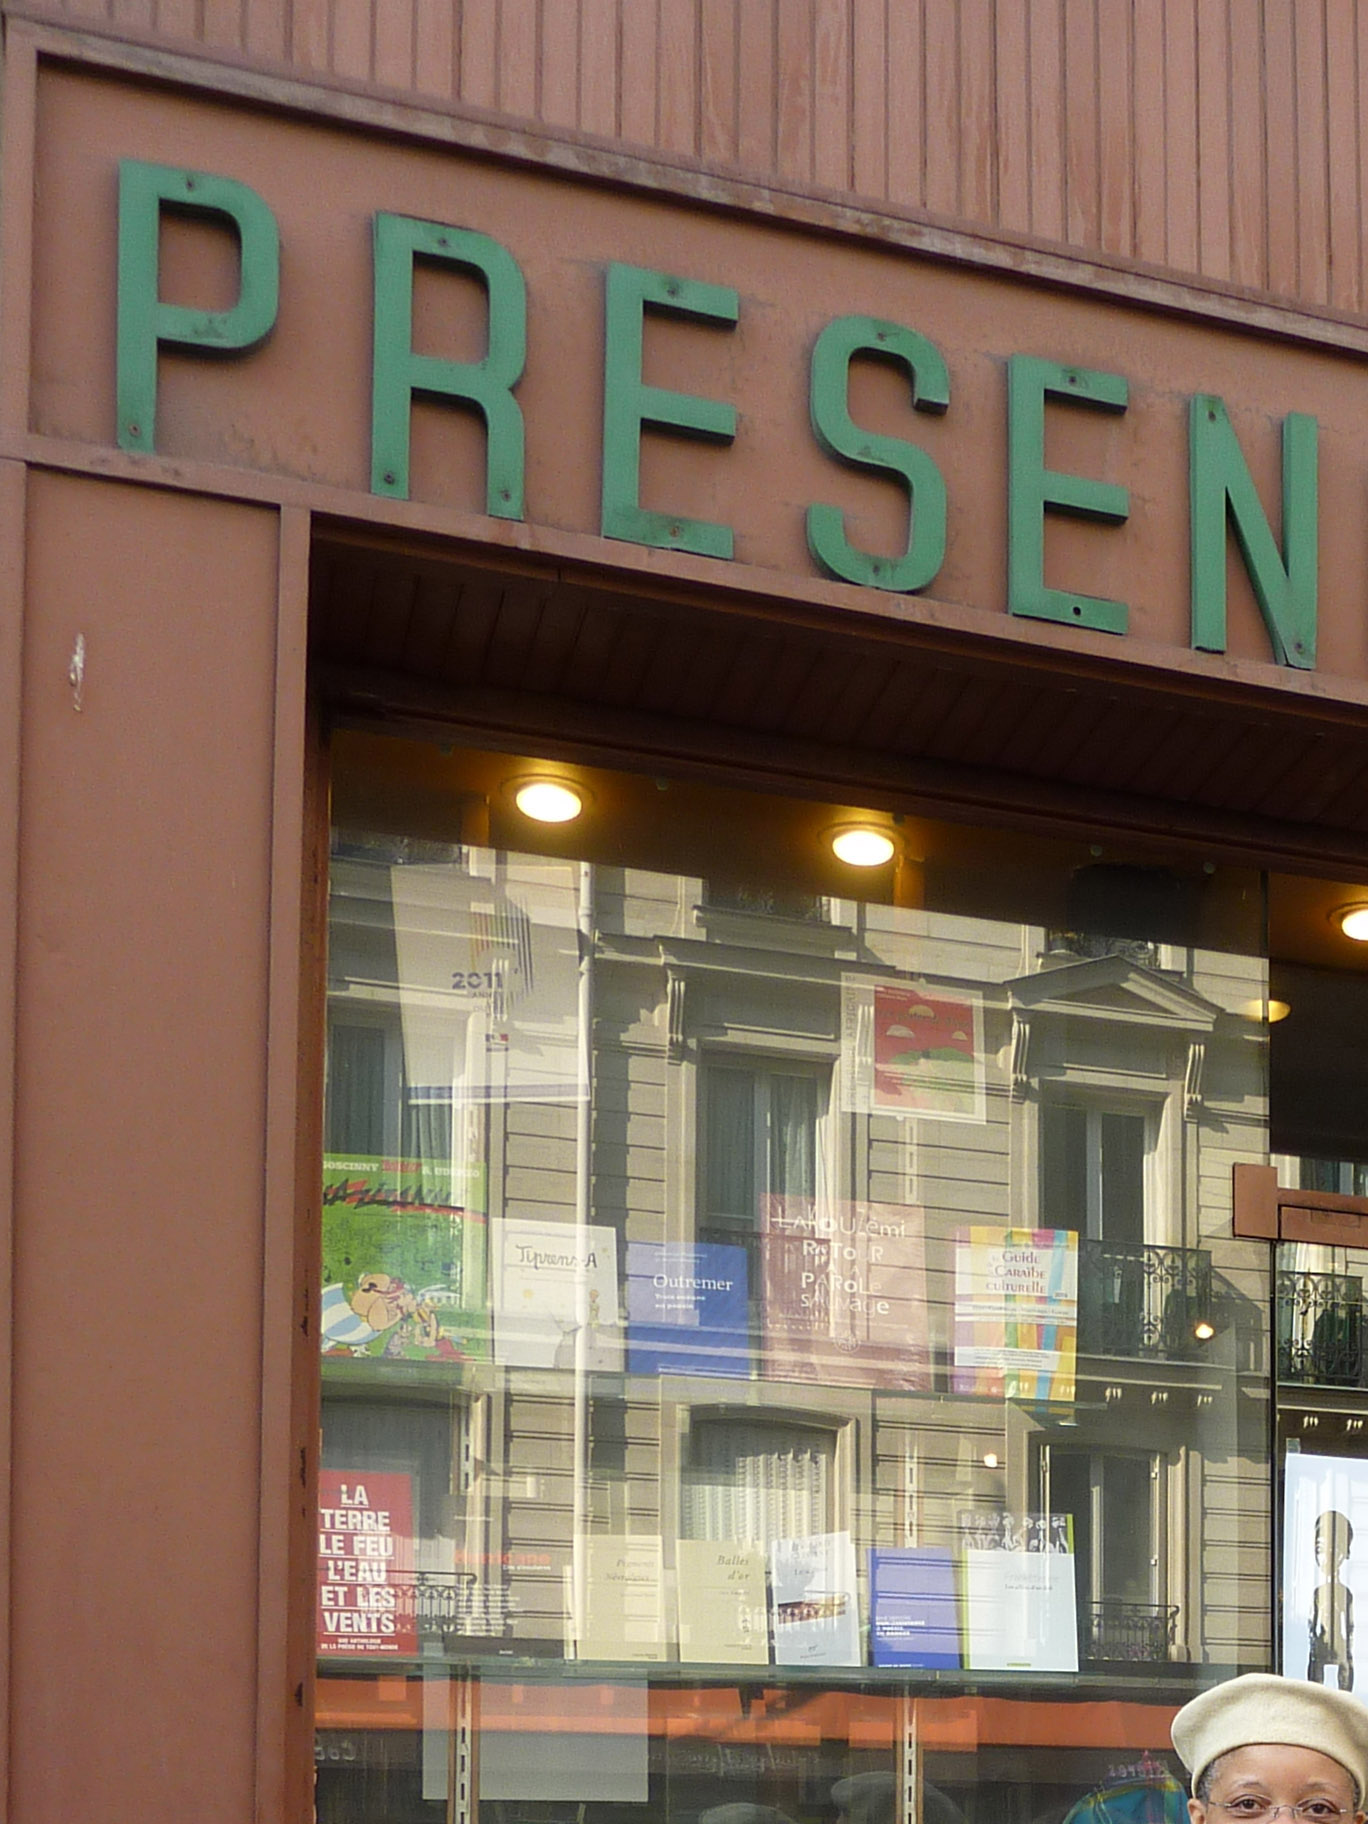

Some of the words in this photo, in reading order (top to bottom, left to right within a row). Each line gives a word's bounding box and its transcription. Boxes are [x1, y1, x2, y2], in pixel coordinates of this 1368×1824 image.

[452, 971, 503, 990] 2011
[653, 1273, 734, 1292] Outremer
[339, 1484, 369, 1505] LA
[320, 1509, 391, 1531] TERRE
[319, 1534, 345, 1555] LE
[353, 1535, 394, 1557] FEU
[716, 1554, 750, 1567] Balles
[327, 1561, 387, 1582] L'EAU
[321, 1586, 348, 1606] ET
[357, 1587, 395, 1608] LES
[323, 1612, 395, 1633] VENTS
